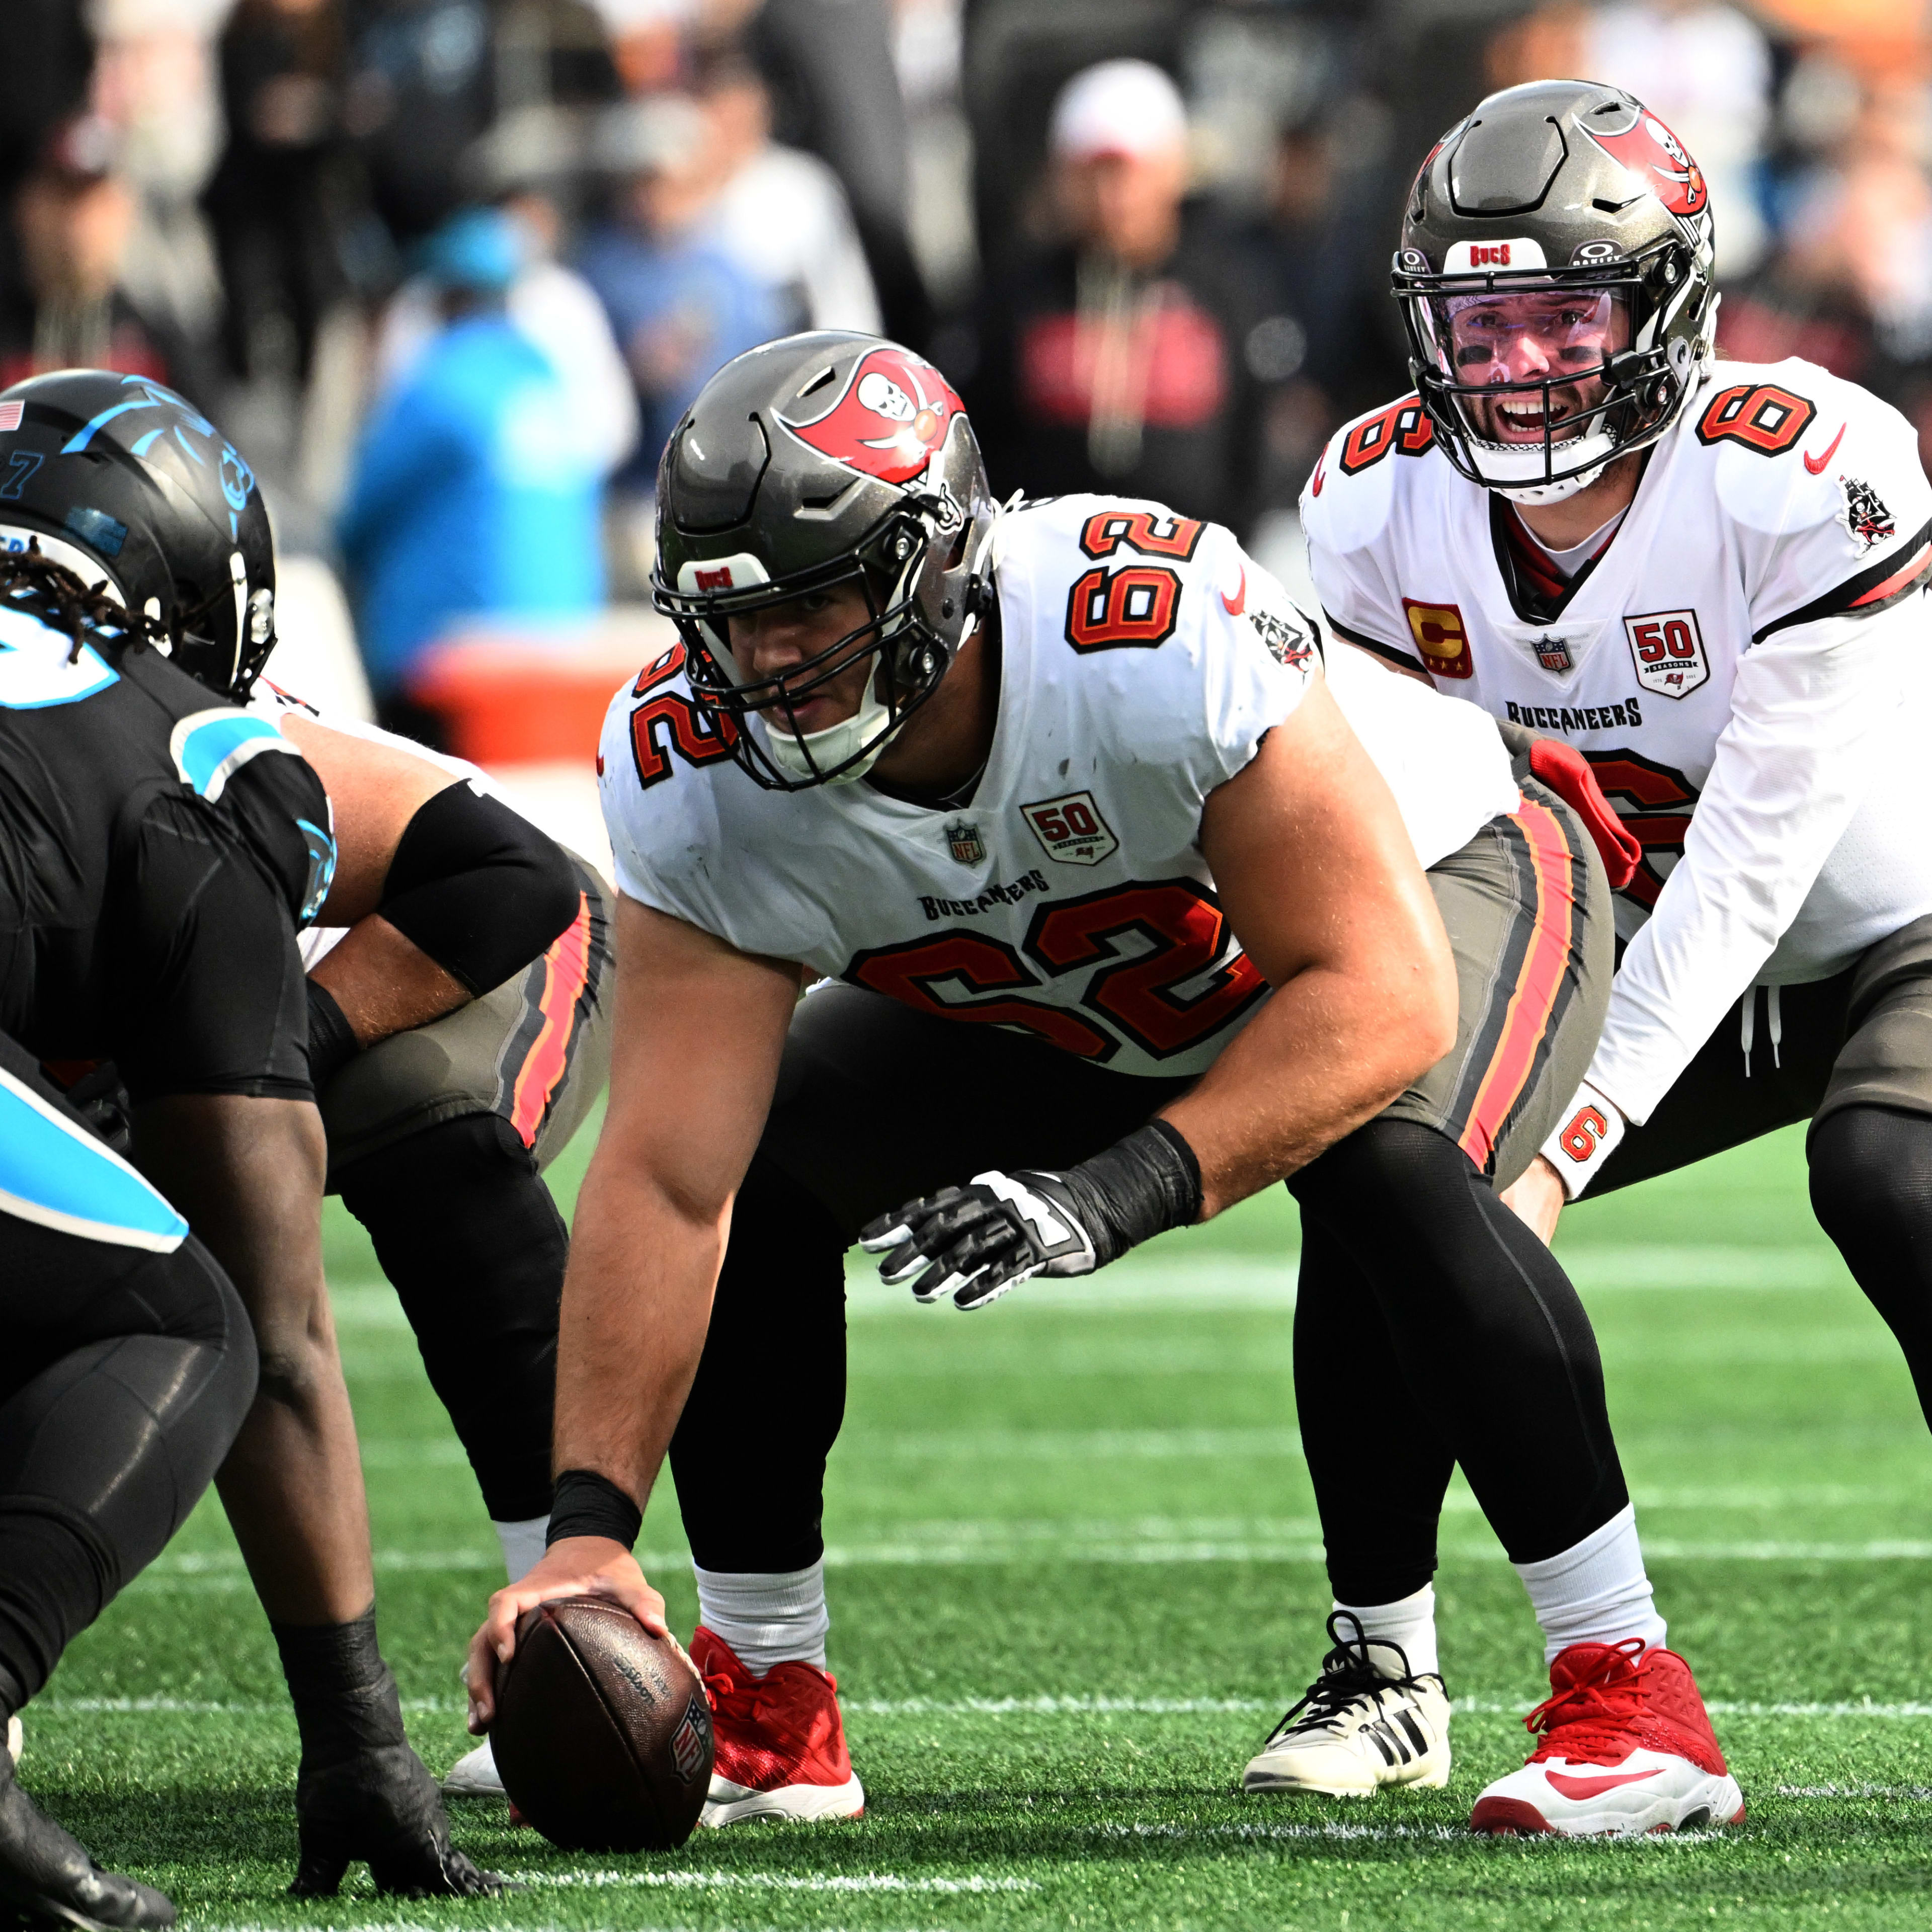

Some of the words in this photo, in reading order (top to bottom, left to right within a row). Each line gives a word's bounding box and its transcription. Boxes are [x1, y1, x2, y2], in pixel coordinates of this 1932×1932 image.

[1470, 244, 1511, 266] BUCS
[1339, 394, 1437, 476] 6
[1695, 384, 1817, 458] 6
[1064, 511, 1208, 655] 62
[1408, 606, 1463, 659] C
[1633, 620, 1695, 663] 50
[1541, 654, 1569, 669] NFL
[1652, 662, 1689, 671] SEASONS
[1505, 697, 1642, 737] BUCCANEERS
[1032, 802, 1099, 842] 50
[952, 842, 980, 860] NFL
[840, 876, 1273, 1063] 62
[1560, 1105, 1607, 1163] 6
[674, 1722, 702, 1780] NFL
